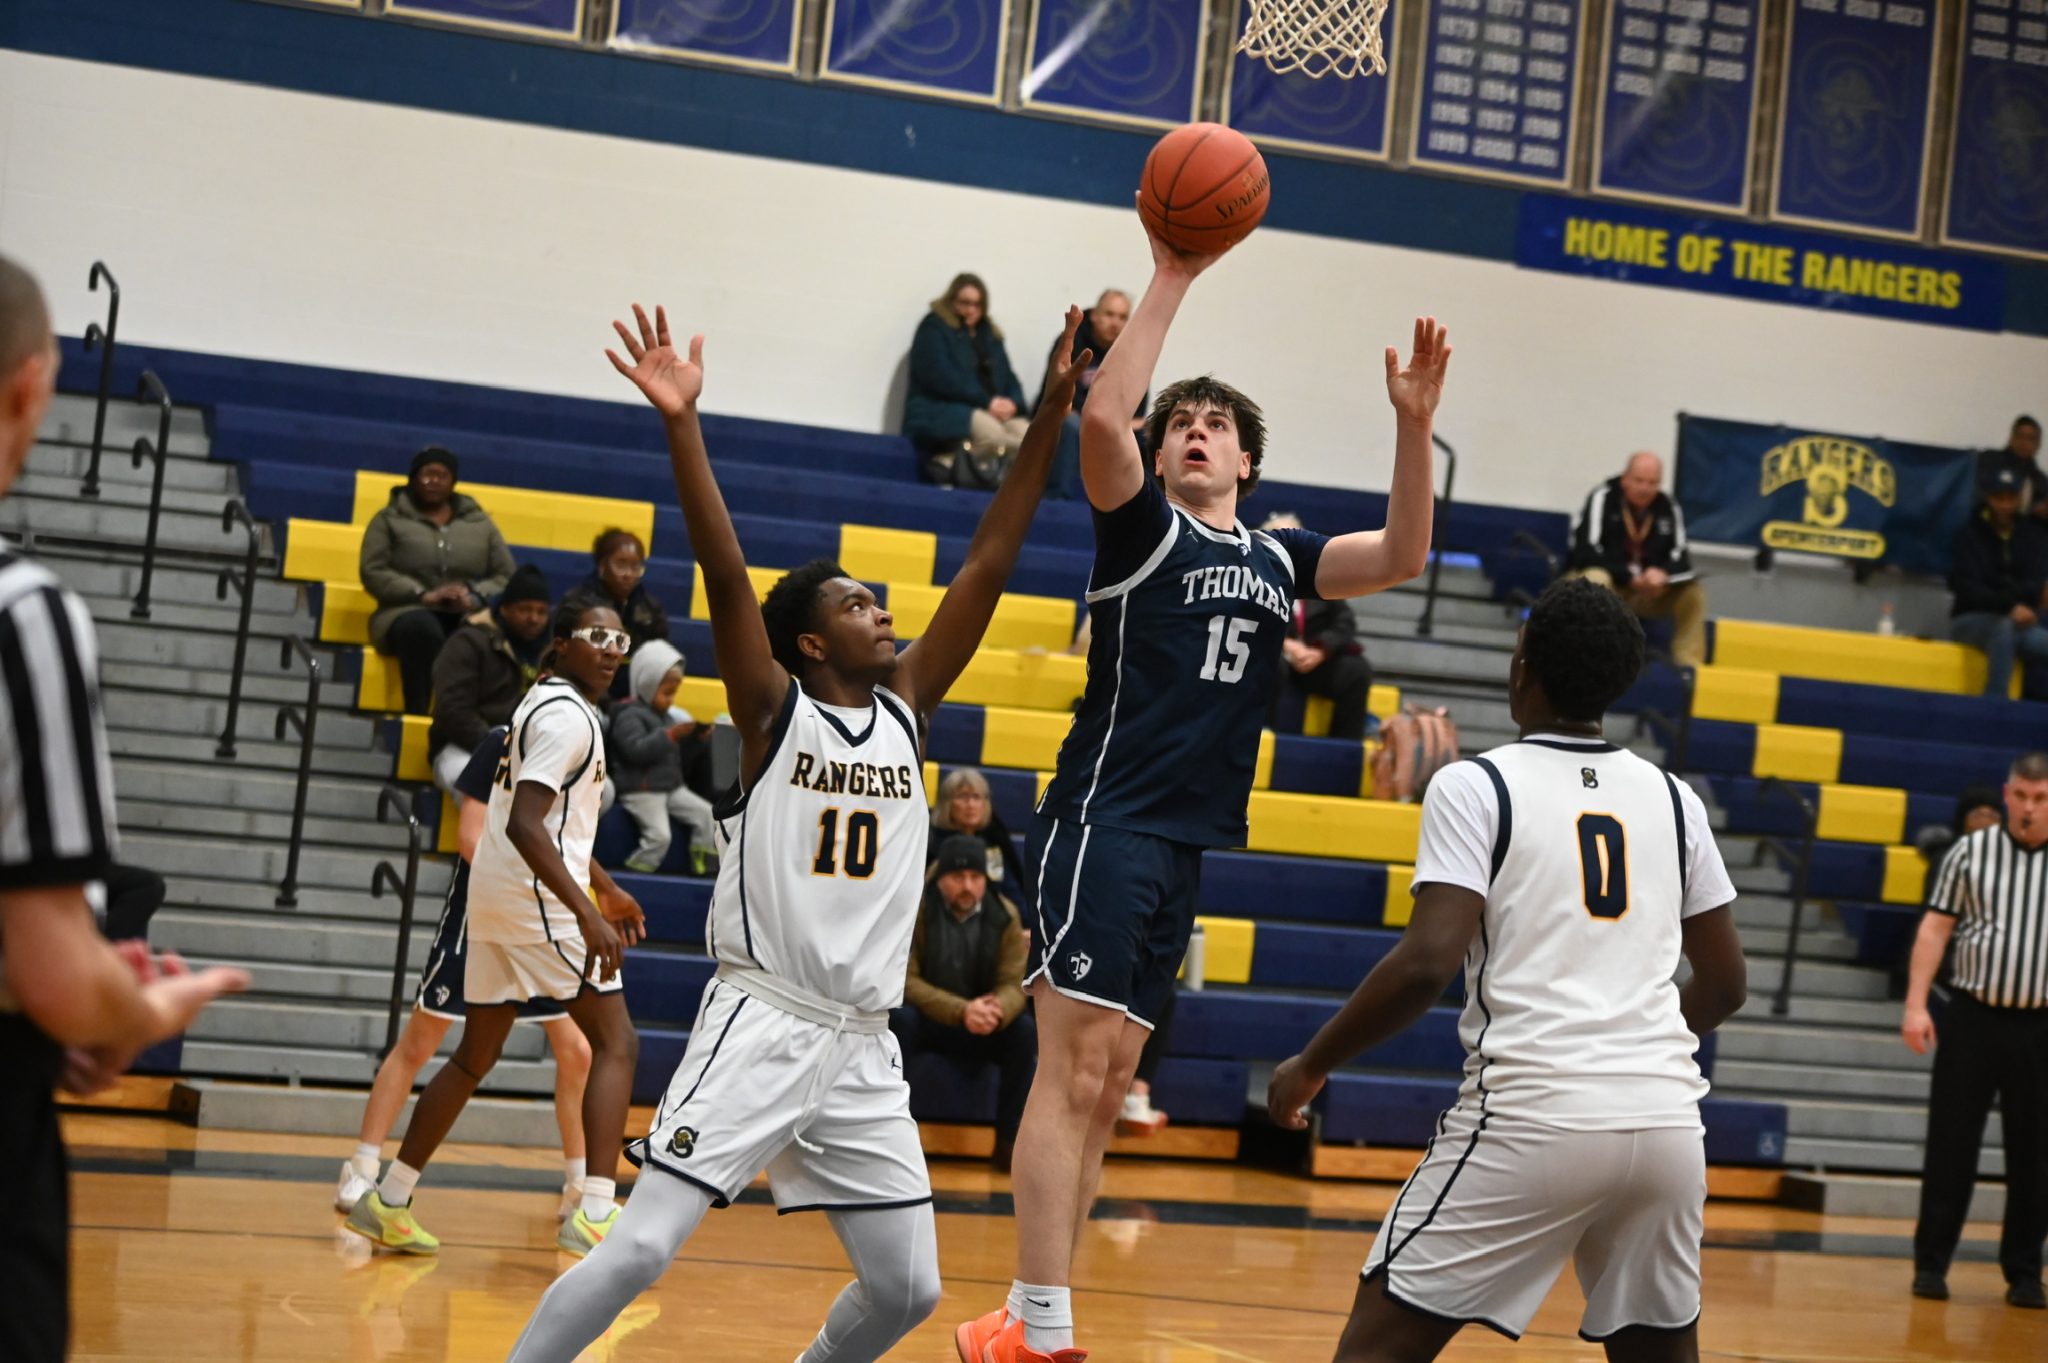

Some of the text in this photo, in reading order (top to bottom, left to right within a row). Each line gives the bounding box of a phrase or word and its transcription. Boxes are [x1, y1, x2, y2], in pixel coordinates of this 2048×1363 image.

[1563, 216, 1962, 309] HOME OF THE RANGERS
[1760, 434, 1897, 508] RANGERS
[1182, 565, 1290, 623] THOMAS
[1199, 615, 1260, 684] 15
[790, 750, 912, 800] RANGERS
[811, 806, 880, 880] 10
[1575, 811, 1631, 922] 0
